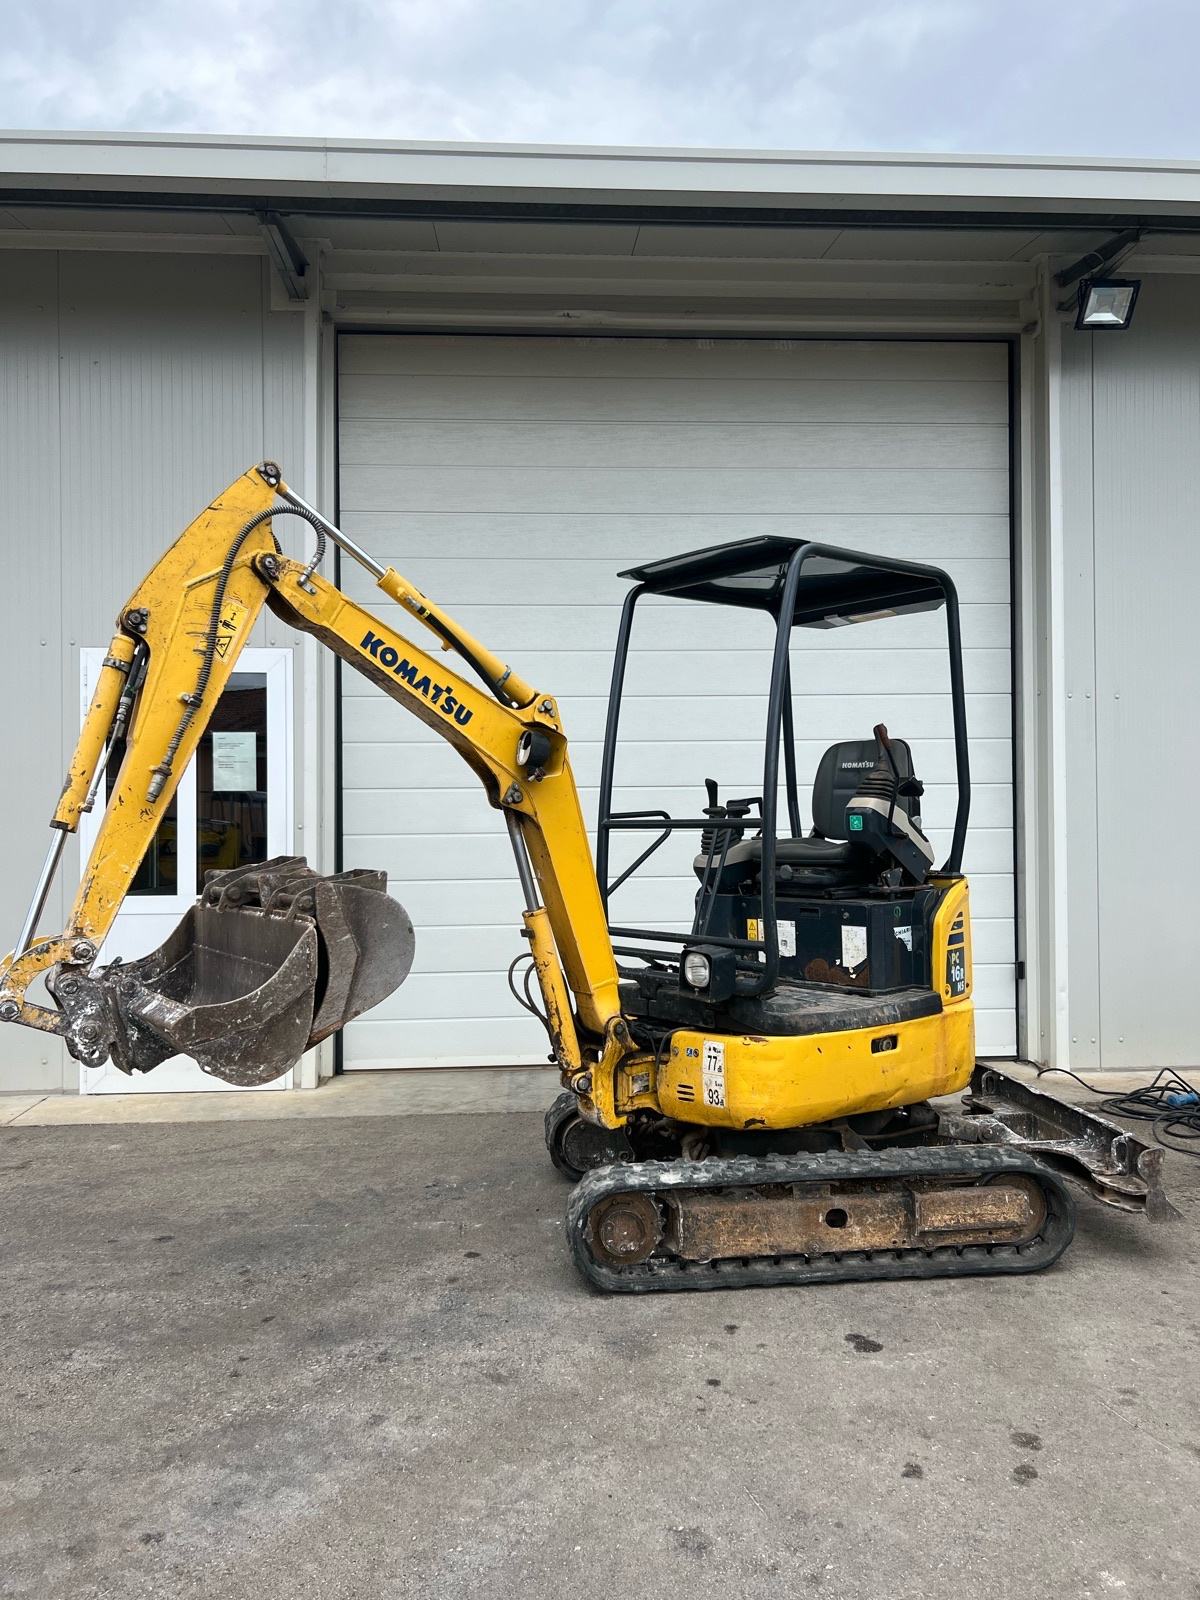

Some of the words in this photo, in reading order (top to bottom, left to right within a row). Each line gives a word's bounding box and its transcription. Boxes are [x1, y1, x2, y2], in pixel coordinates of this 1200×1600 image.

[360, 630, 473, 725] KOMATSU
[951, 952, 959, 964] PC
[707, 1055, 717, 1071] 77
[708, 1089, 719, 1105] 93
